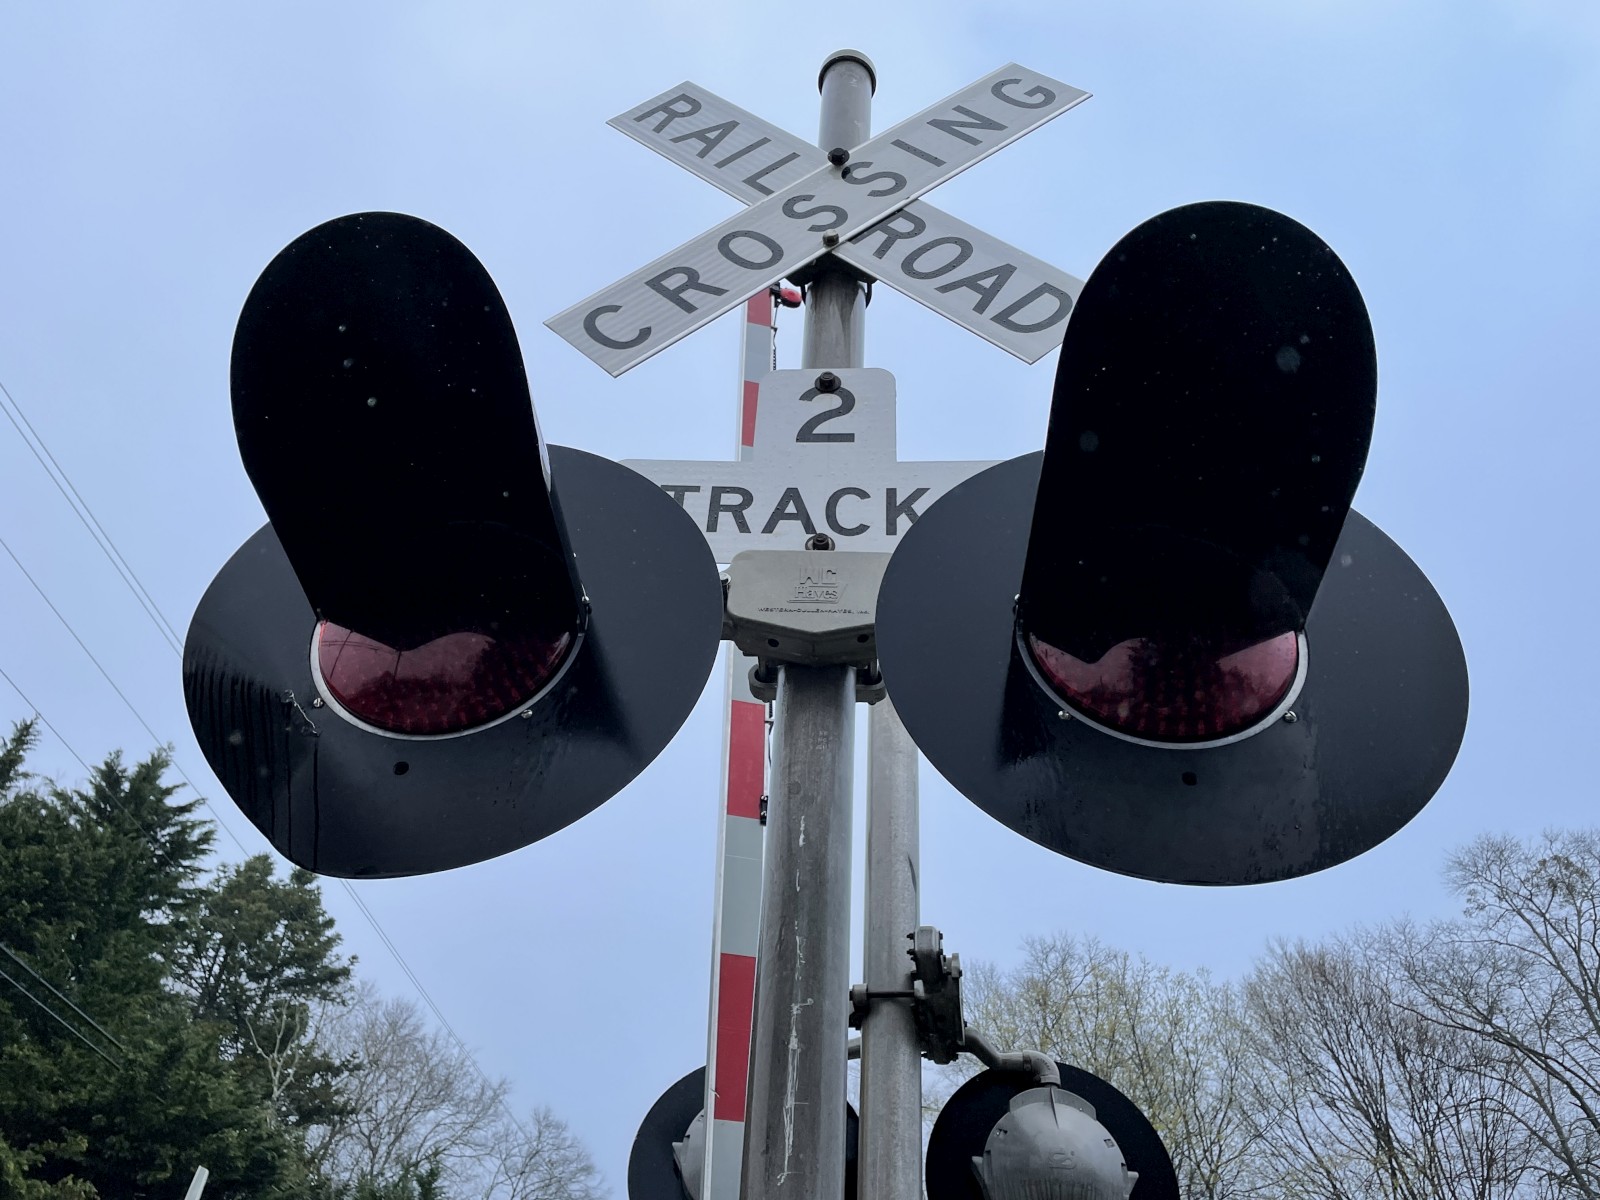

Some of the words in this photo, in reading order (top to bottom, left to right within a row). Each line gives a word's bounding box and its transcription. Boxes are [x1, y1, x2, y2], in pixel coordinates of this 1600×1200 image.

[582, 77, 1057, 350] CROSSING
[633, 93, 801, 196] RAIL
[850, 207, 1074, 334] ROAD
[795, 384, 857, 444] 2
[661, 484, 931, 537] TRACK
[794, 586, 839, 601] Hayes
